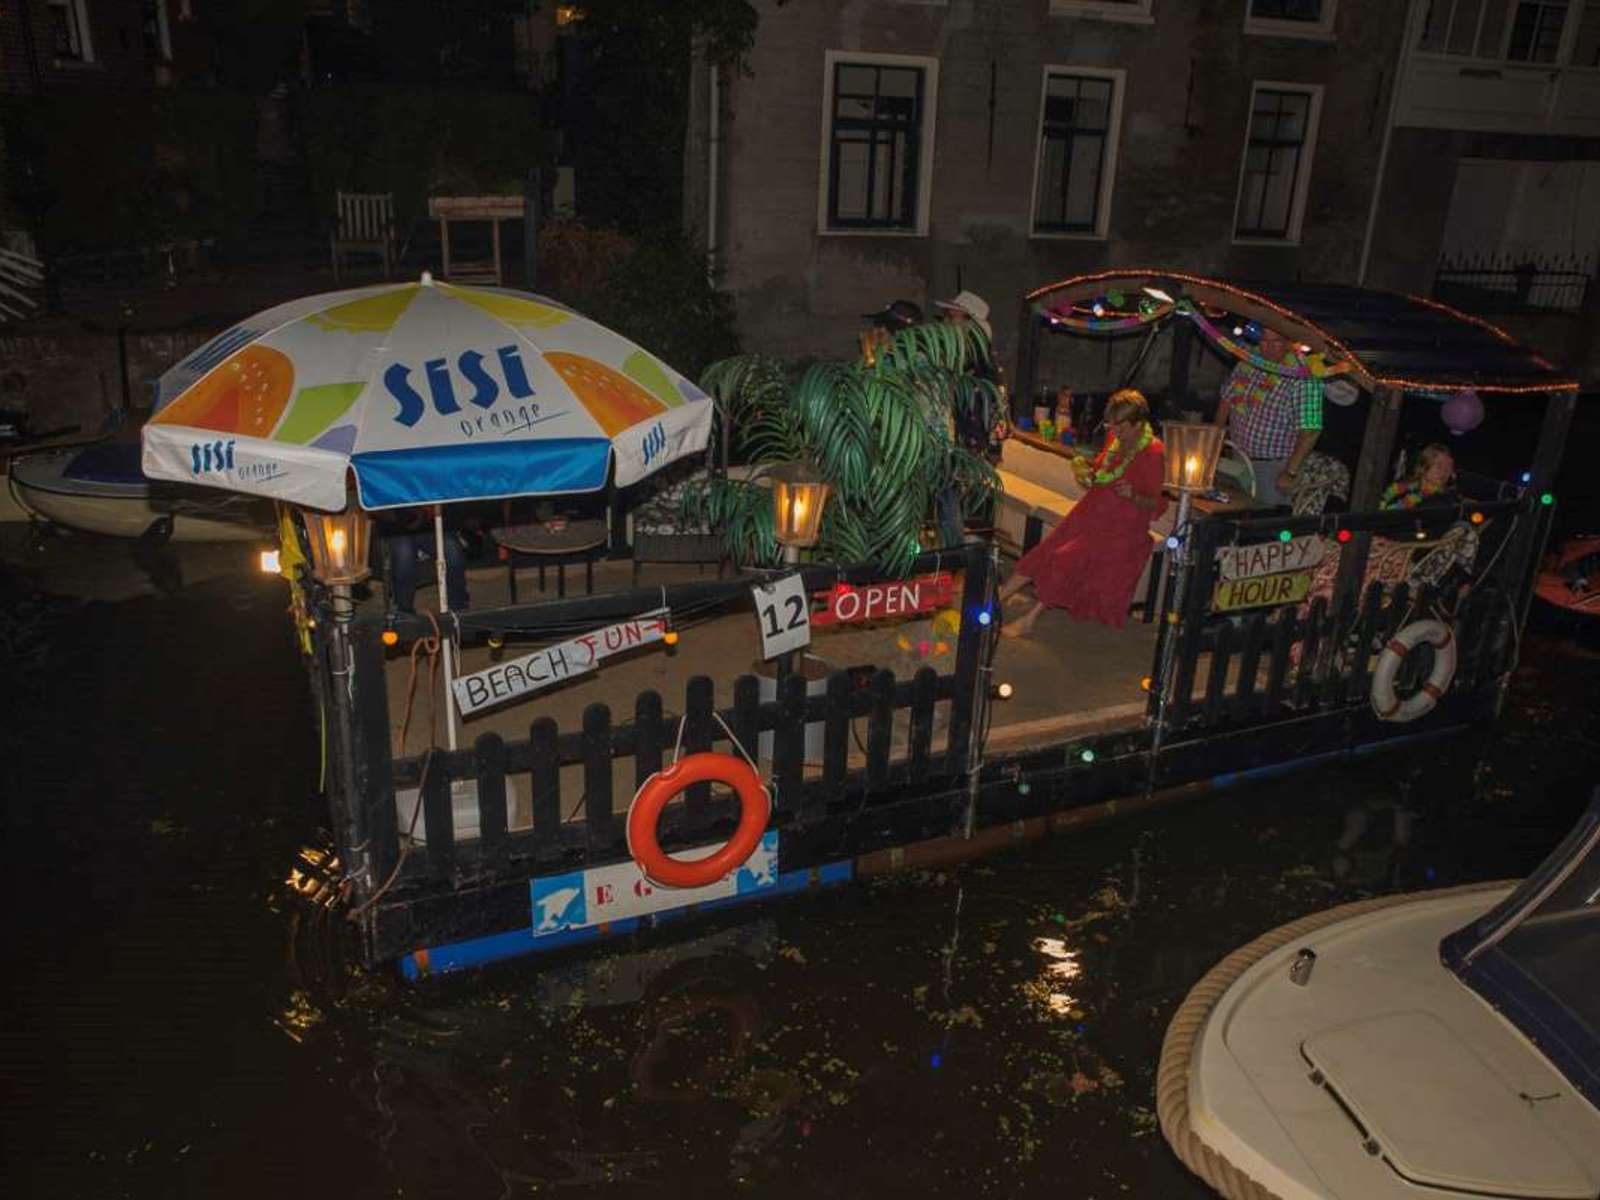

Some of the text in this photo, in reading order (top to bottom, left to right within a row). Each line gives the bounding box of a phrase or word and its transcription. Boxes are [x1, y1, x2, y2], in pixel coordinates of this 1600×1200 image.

[459, 402, 543, 437] orange
[1234, 537, 1311, 577] HAPPY
[835, 583, 921, 620] OPEN
[1228, 576, 1293, 607] HOUR
[763, 594, 807, 639] 12
[465, 622, 642, 708] BEACH FUN
